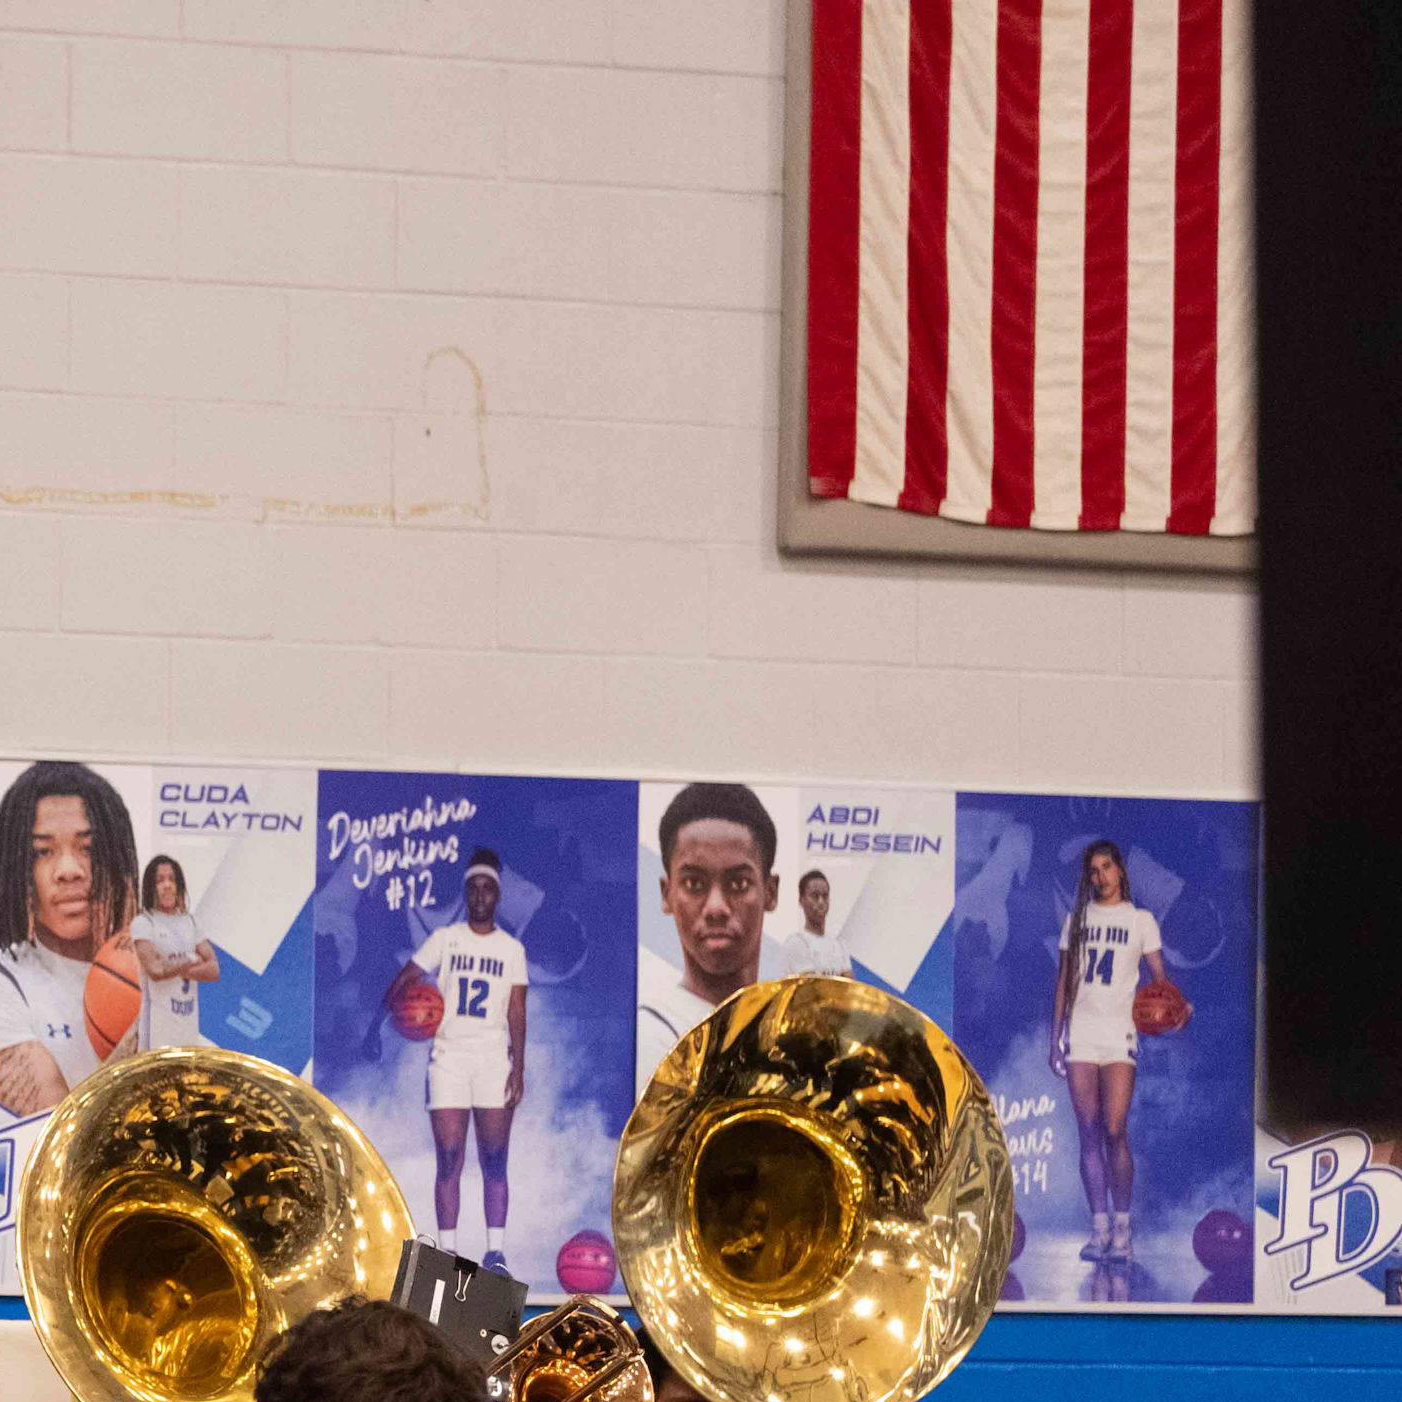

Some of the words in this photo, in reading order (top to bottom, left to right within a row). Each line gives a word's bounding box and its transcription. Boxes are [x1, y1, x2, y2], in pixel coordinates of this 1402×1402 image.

[159, 783, 250, 805] CUDA
[159, 810, 303, 832] CLAYTON
[806, 803, 880, 826] ABDI
[806, 832, 942, 855] HUSSEIN
[352, 834, 459, 889] Jenkins
[385, 869, 436, 911] #12
[1084, 948, 1115, 985] 14
[456, 977, 490, 1018] 12
